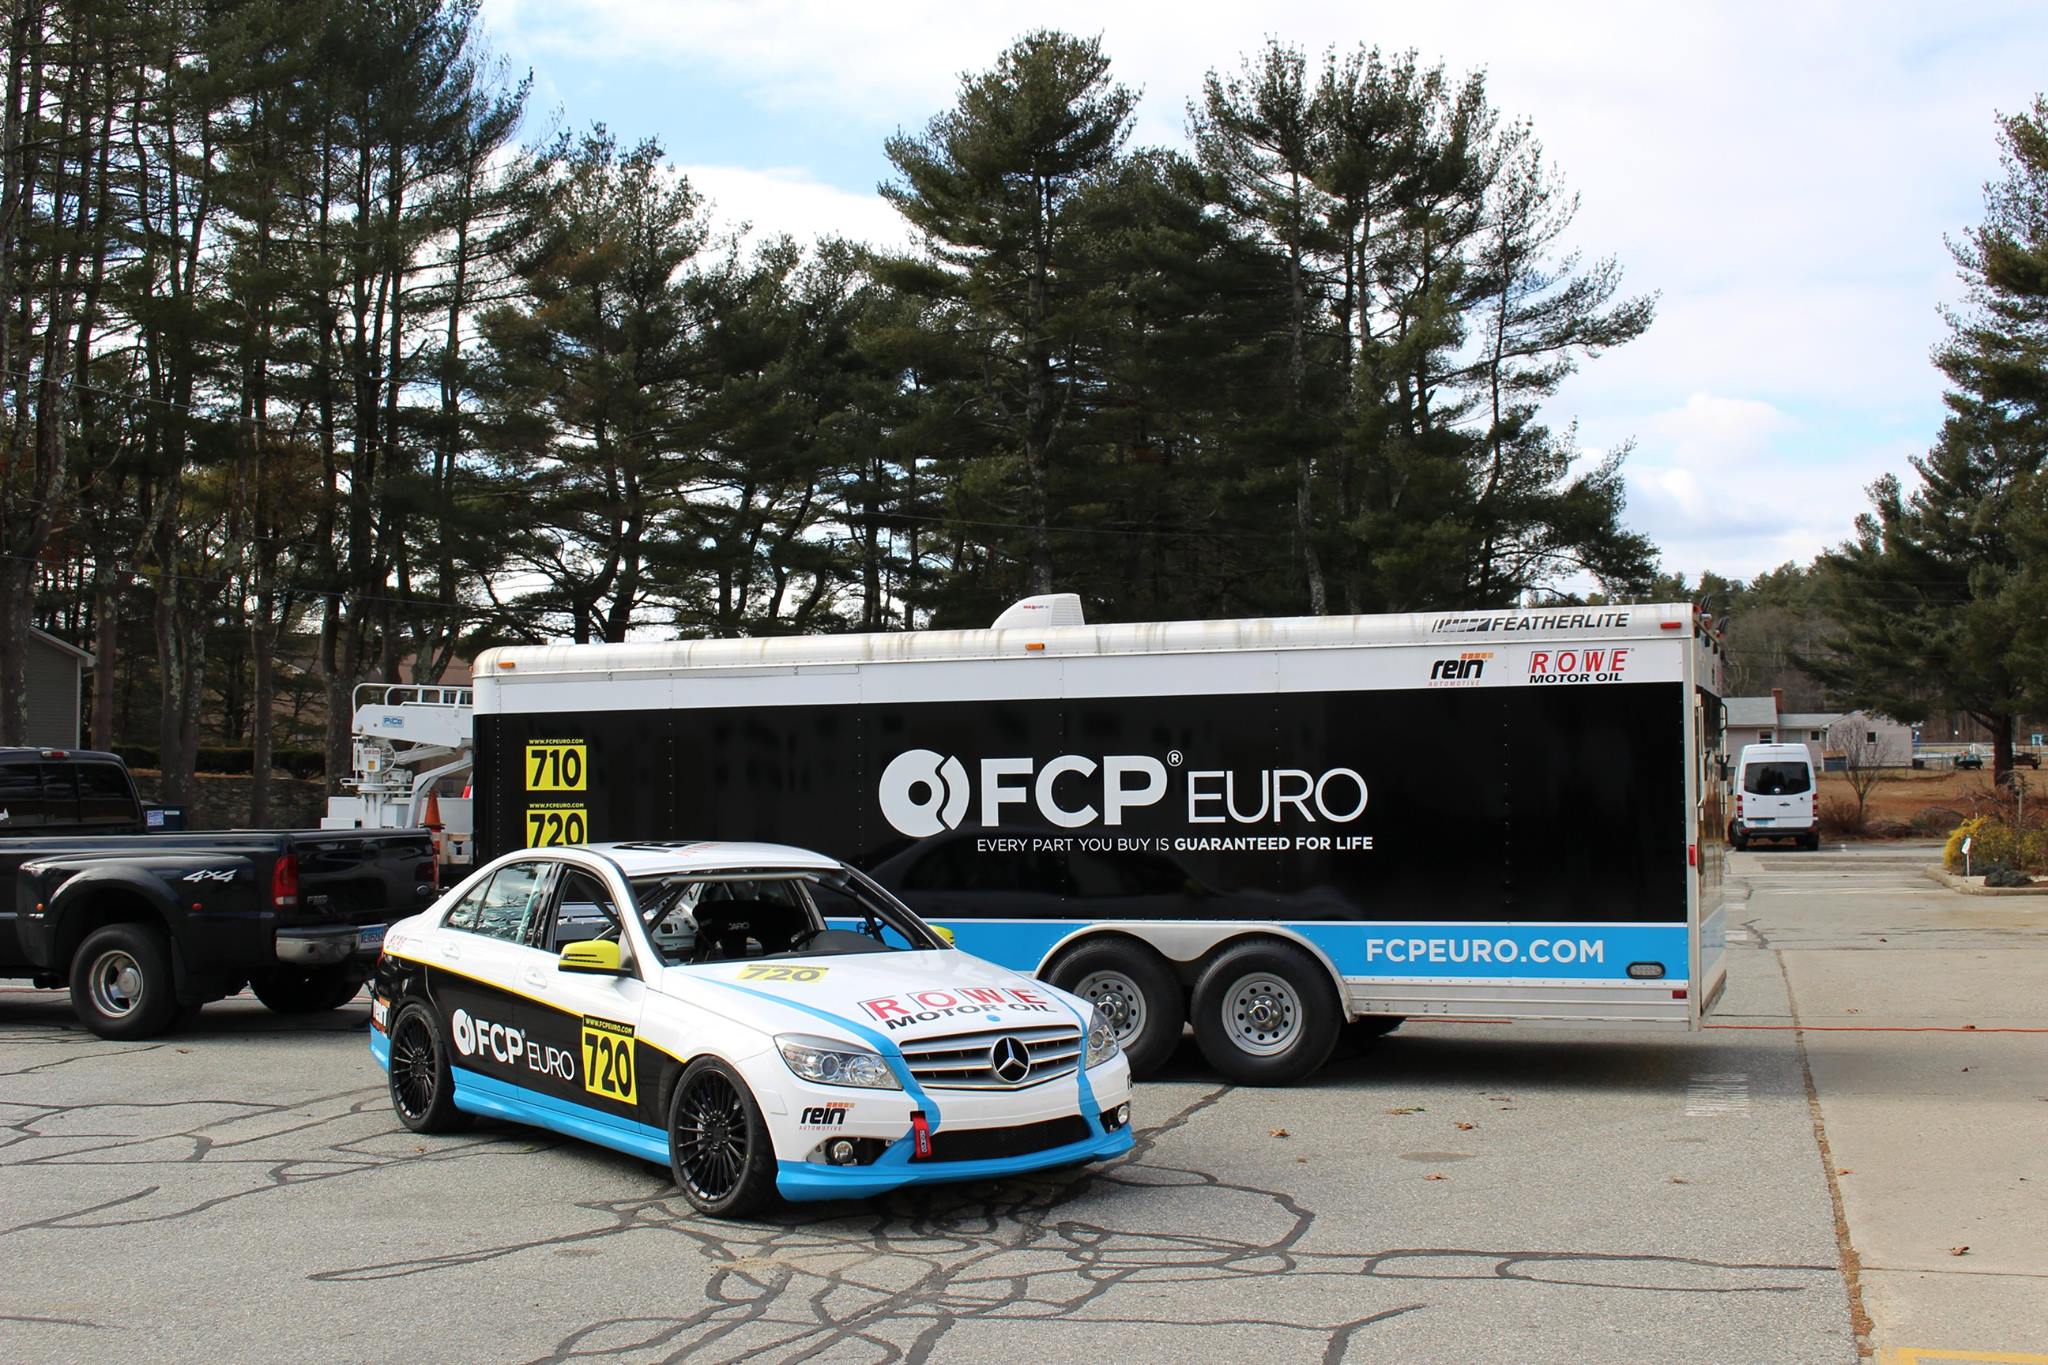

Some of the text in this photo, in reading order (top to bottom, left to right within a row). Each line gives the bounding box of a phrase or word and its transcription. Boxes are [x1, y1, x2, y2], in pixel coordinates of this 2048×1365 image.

[1491, 613, 1630, 631] FEATHERLITE
[1430, 659, 1485, 680] rein
[1530, 649, 1629, 674] ROWE
[1529, 672, 1623, 684] MOTOR OIL
[531, 748, 582, 788] 710
[1187, 767, 1369, 824] EURO
[530, 812, 585, 848] 720
[977, 836, 1374, 852] EVERY PART YOU BUY IS GUARANTEED FOR LIFE
[1366, 938, 1605, 963] FCPEURO.COM
[742, 967, 821, 983] 720
[861, 988, 1049, 1020] ROWE
[885, 1003, 1058, 1030] MOTOR OIL
[526, 1040, 575, 1081] EURO
[585, 1032, 633, 1098] 720
[800, 1107, 847, 1125] rein
